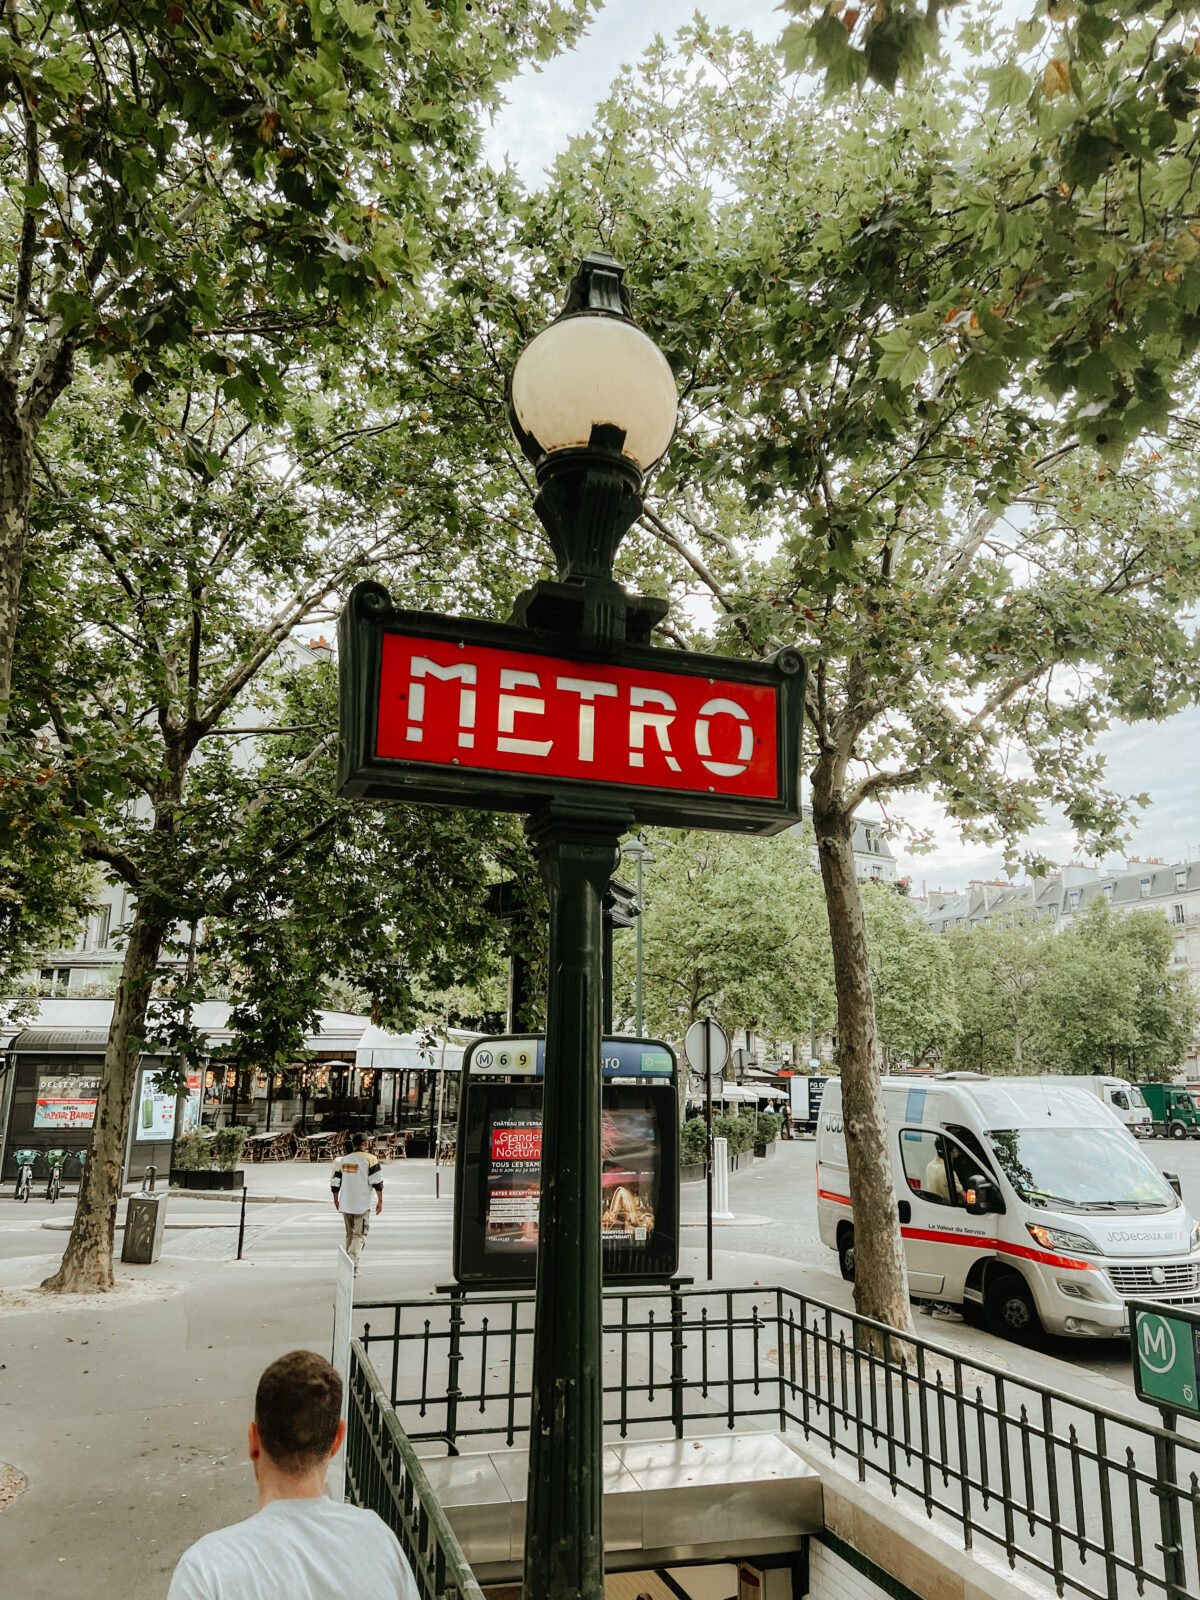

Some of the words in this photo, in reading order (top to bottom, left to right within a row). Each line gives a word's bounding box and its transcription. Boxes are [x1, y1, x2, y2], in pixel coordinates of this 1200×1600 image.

[405, 655, 754, 777] METRO
[500, 1054, 507, 1065] 6
[520, 1054, 527, 1065] 9
[69, 1111, 94, 1120] BANDE
[508, 1139, 534, 1149] Eaux
[496, 1148, 540, 1157] Nocturn
[1107, 1231, 1163, 1241] JCDecaux
[1143, 1322, 1167, 1360] M
